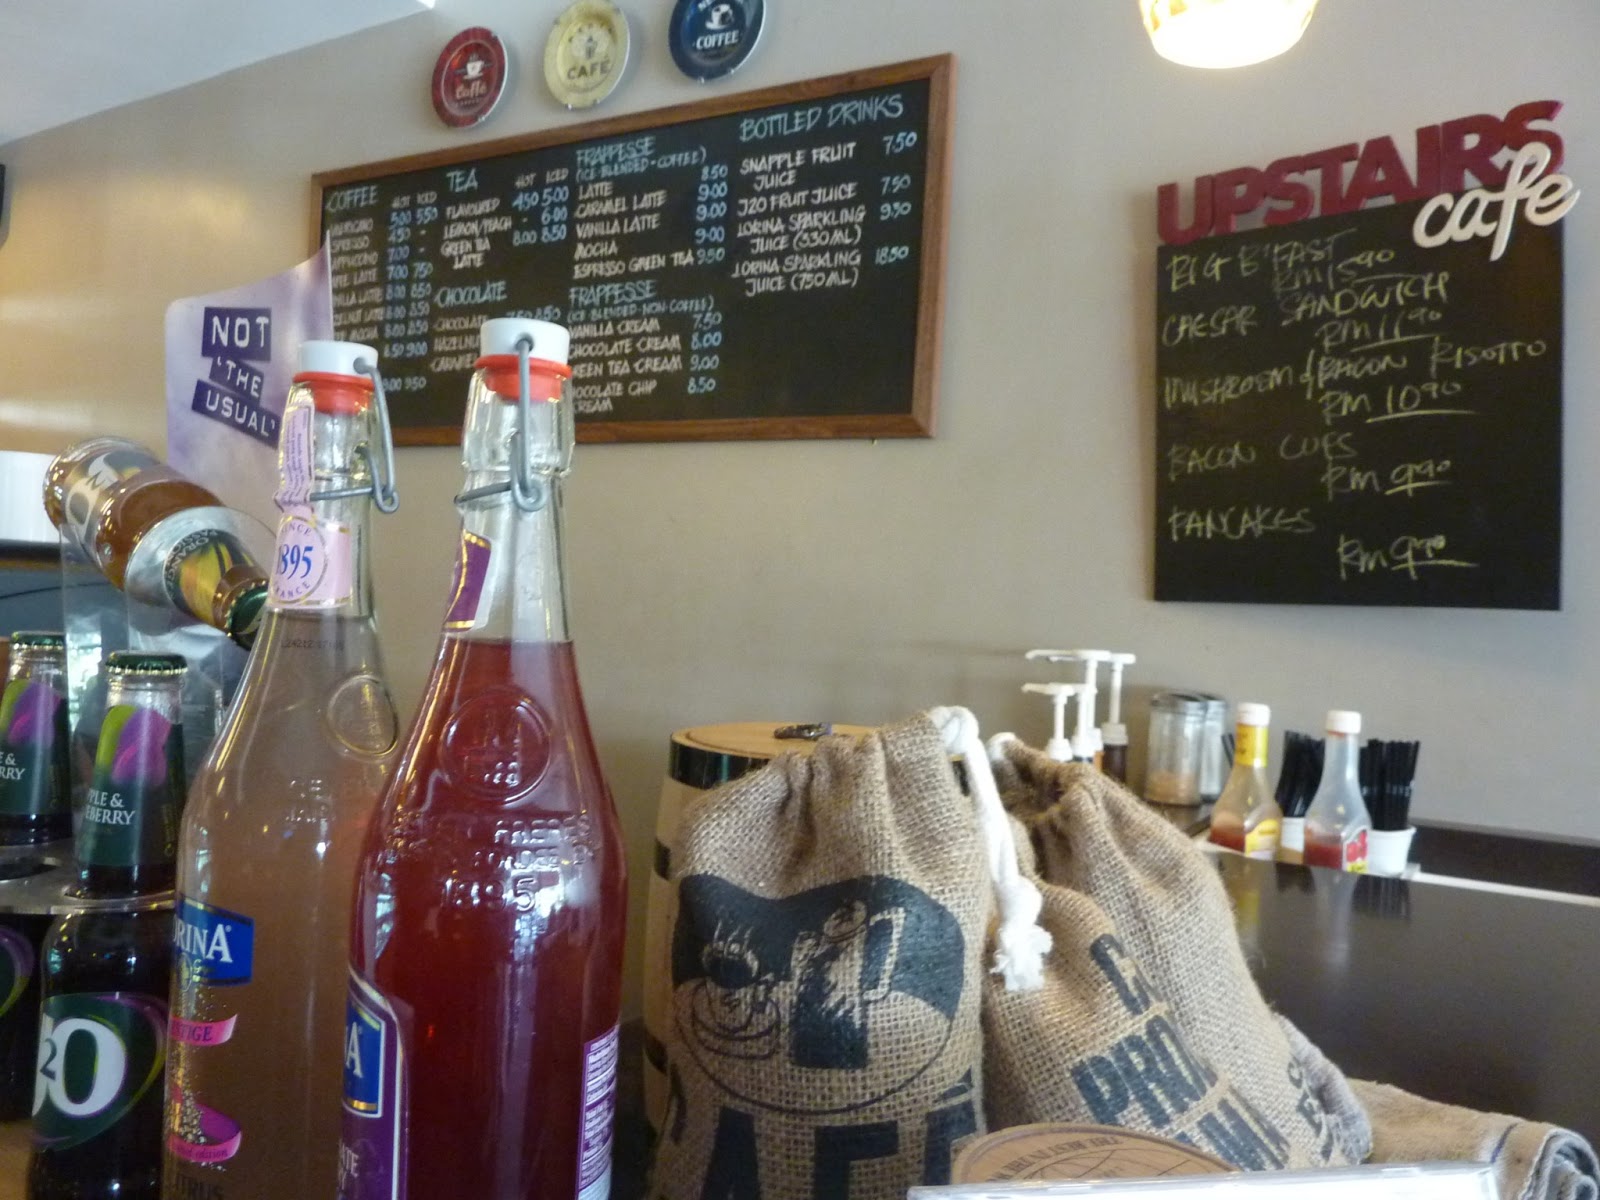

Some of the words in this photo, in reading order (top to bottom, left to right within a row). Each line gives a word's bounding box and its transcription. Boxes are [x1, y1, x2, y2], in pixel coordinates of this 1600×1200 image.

[696, 30, 740, 50] COFFEE
[739, 106, 822, 142] BOTTLED
[827, 94, 904, 128] DRINKS
[740, 149, 806, 176] SNAPPLE
[812, 142, 857, 164] FRUIT
[446, 168, 478, 192] TEA
[753, 169, 797, 192] JUICE
[1157, 100, 1565, 245] UPSTAIRS
[326, 185, 378, 212] COFFEE
[578, 180, 614, 201] LATTE
[770, 190, 810, 212] FRUIT
[811, 182, 859, 204] JUICE
[1412, 141, 1580, 261] cafe
[573, 196, 628, 219] CARAMEL
[632, 190, 668, 211] LATTE
[575, 218, 620, 239] VANILLA
[623, 213, 661, 235] LATTE
[737, 216, 786, 238] LORINA
[788, 204, 867, 231] SPARKLING
[573, 239, 618, 261] MOCHA
[749, 234, 789, 255] JUICE
[453, 252, 484, 270] LATTE
[573, 260, 626, 280] ESPRESSO
[628, 254, 666, 272] GREEN
[670, 248, 695, 268] TEA
[731, 257, 780, 278] LORINA
[782, 249, 862, 274] SPARKLING
[1167, 252, 1230, 291] BIG
[433, 280, 507, 308] CHOCOLATE
[745, 275, 786, 298] JUICE
[212, 315, 269, 348] NOT
[569, 320, 614, 339] VANILLA
[616, 317, 660, 335] CREAM
[636, 334, 682, 353] CREAM
[1429, 336, 1548, 377] RISOTTO
[572, 363, 603, 379] REEN
[607, 360, 631, 377] TEA
[633, 354, 683, 375] CREAM
[628, 379, 657, 396] CHIP
[1167, 441, 1256, 482] BACON
[281, 523, 312, 537] INCE
[1168, 504, 1316, 543] PANCAKES
[110, 793, 124, 808] &
[86, 804, 135, 825] EBERRY
